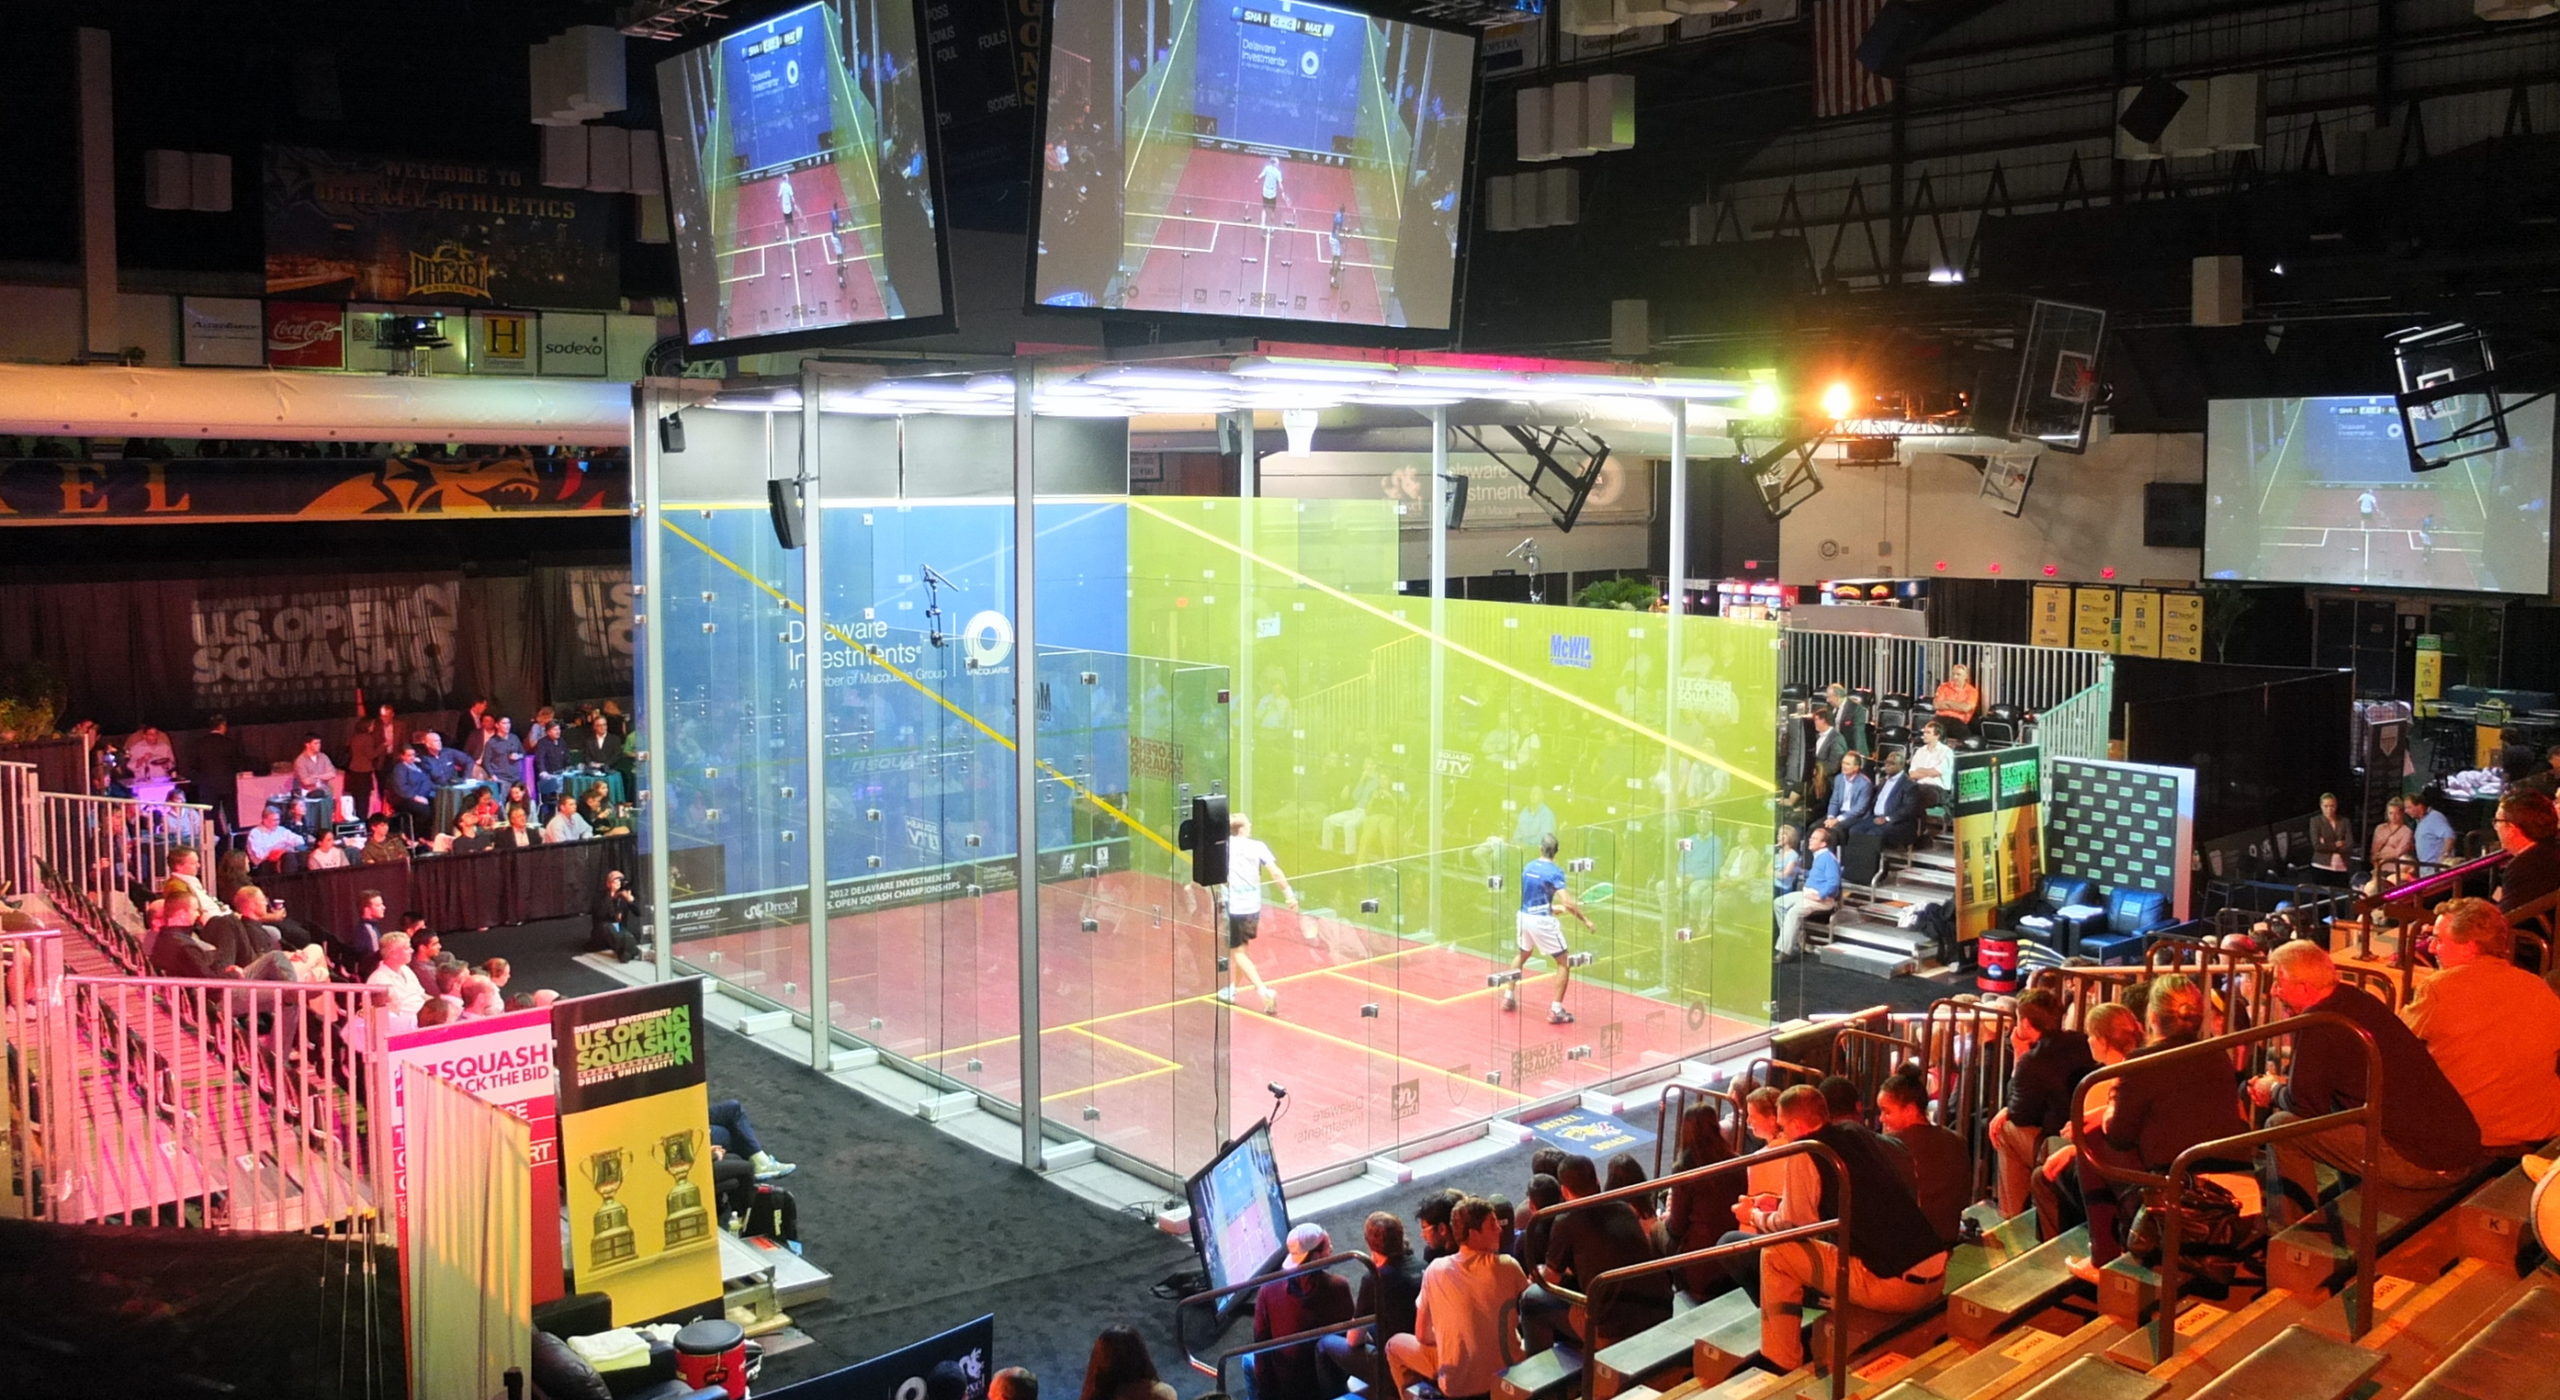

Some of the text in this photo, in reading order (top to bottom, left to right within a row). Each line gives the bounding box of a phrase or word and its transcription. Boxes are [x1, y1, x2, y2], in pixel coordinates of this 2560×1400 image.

[1711, 9, 1762, 27] Delaware
[978, 30, 1008, 49] FOULS
[936, 47, 959, 63] FOUL
[987, 94, 1018, 113] SCORE
[385, 161, 521, 187] WELCOME TO
[440, 189, 577, 220] ATHLETICS
[411, 252, 488, 293] DREXEL
[485, 318, 520, 354] H
[545, 338, 603, 356] sodexo
[788, 680, 797, 690] A
[915, 667, 947, 682] Group
[829, 873, 951, 899] 2012 DELAWARE INVESTMENTS
[835, 898, 858, 909] OPEN
[860, 891, 893, 905] SQUASH
[894, 880, 960, 898] CHAMPIONSHIPS
[676, 907, 721, 921] DUNLOP
[574, 1008, 671, 1034] DELAWARE INVESTMENTS
[576, 1015, 672, 1051] U.S. OPEN
[440, 1043, 548, 1081] SQUASH
[577, 1031, 674, 1072] SQUASH
[489, 1070, 519, 1089] THE
[522, 1064, 549, 1082] BID
[578, 1058, 674, 1087] DREXEL UNIVERSITY
[2489, 1217, 2500, 1231] K
[1967, 1305, 1977, 1316] H
